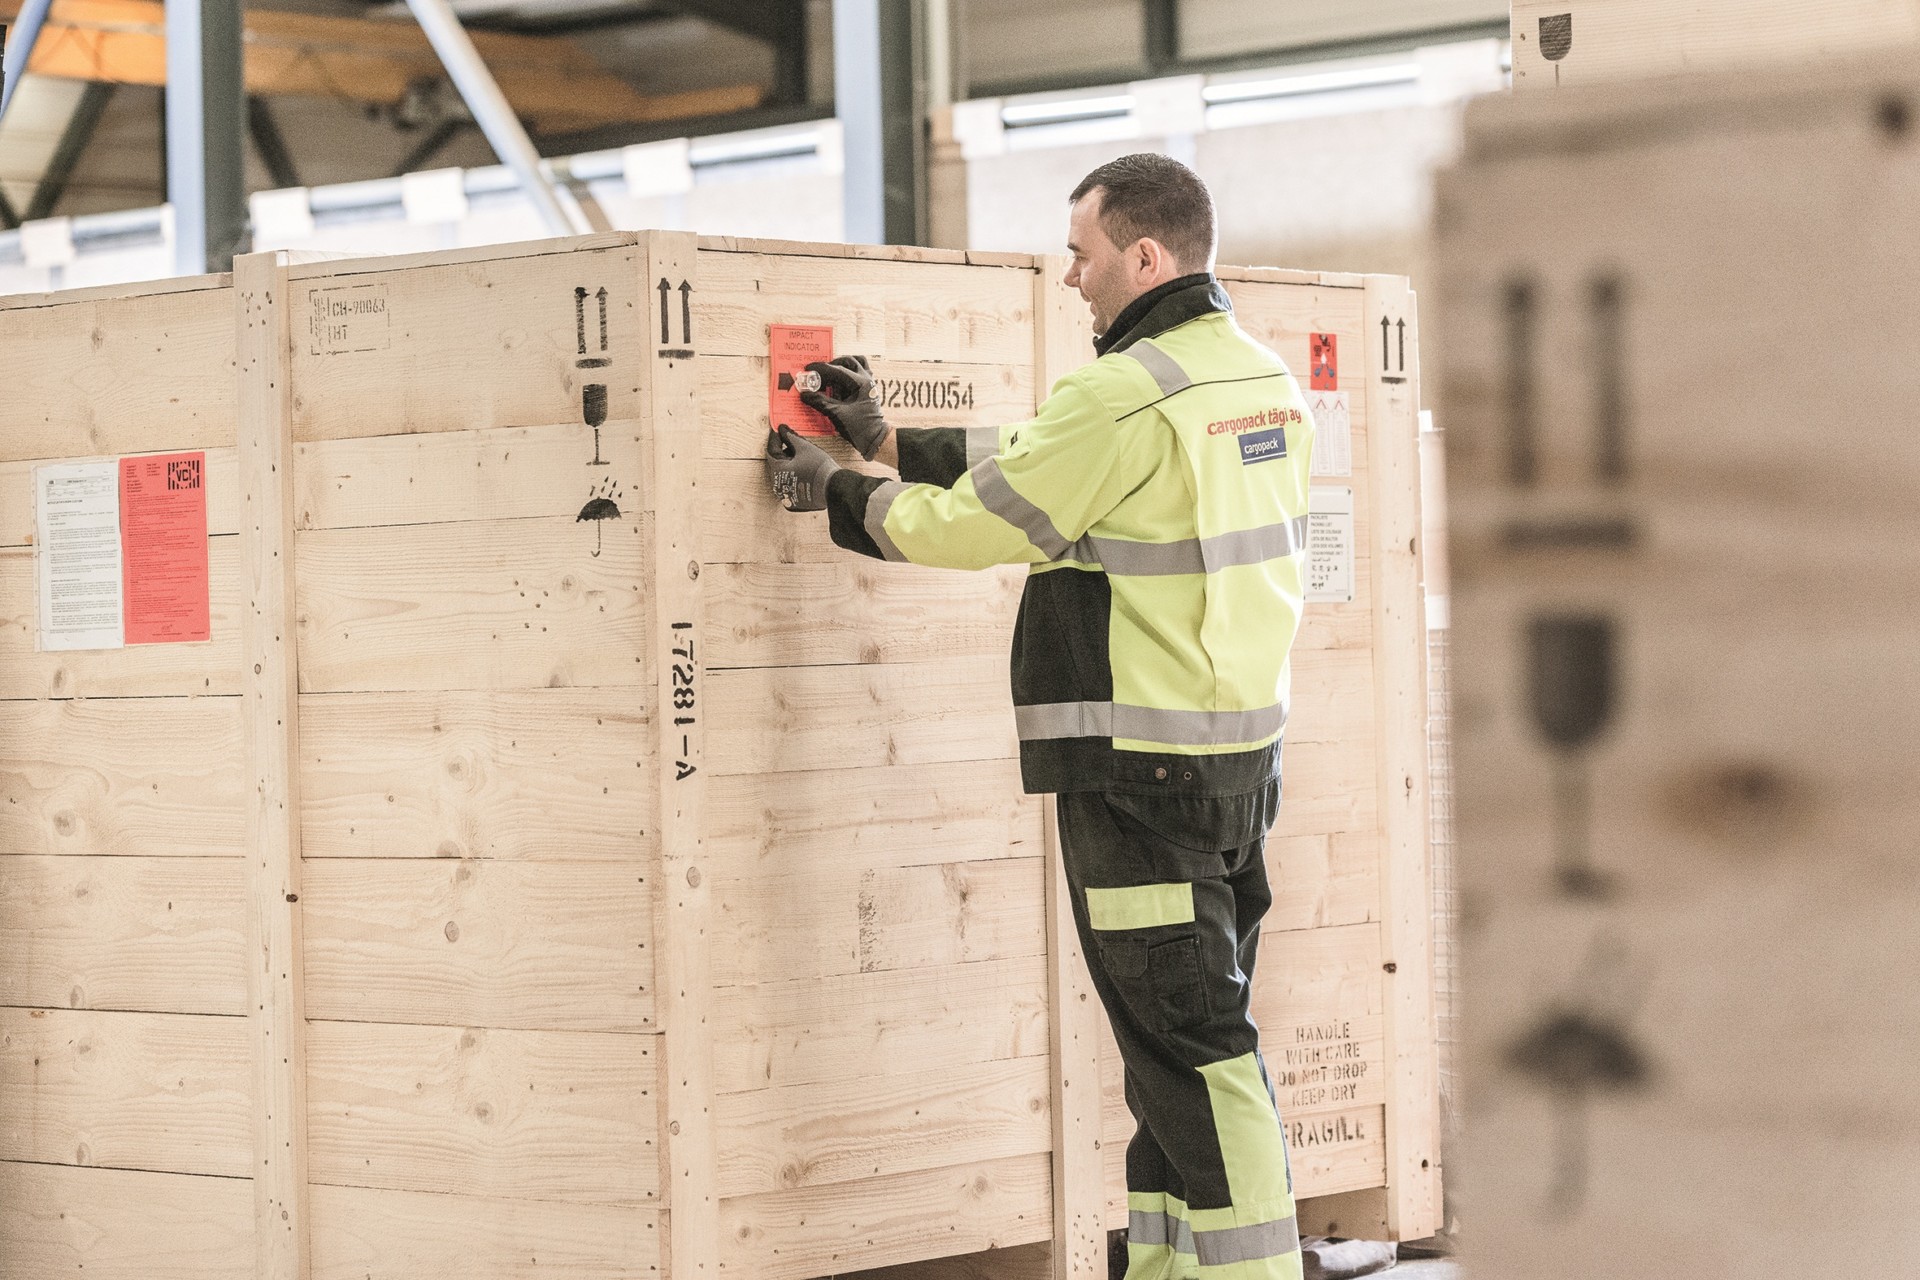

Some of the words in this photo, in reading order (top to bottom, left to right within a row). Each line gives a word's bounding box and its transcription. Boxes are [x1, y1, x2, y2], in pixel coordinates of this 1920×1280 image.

[789, 331, 814, 340] IMPACT
[784, 342, 820, 352] INDICATOR
[1207, 410, 1267, 436] cargopack
[1268, 408, 1289, 427] tägi
[1289, 409, 1302, 424] ag
[1244, 437, 1279, 455] cargopack
[1296, 1021, 1350, 1043] HANDLE
[1286, 1047, 1321, 1065] WITH
[1325, 1042, 1360, 1061] CARE
[1278, 1071, 1296, 1087] DO
[1302, 1066, 1328, 1084] NOT
[1334, 1061, 1368, 1081] DROP
[1292, 1088, 1326, 1107] KEEP
[1331, 1083, 1357, 1101] DRY
